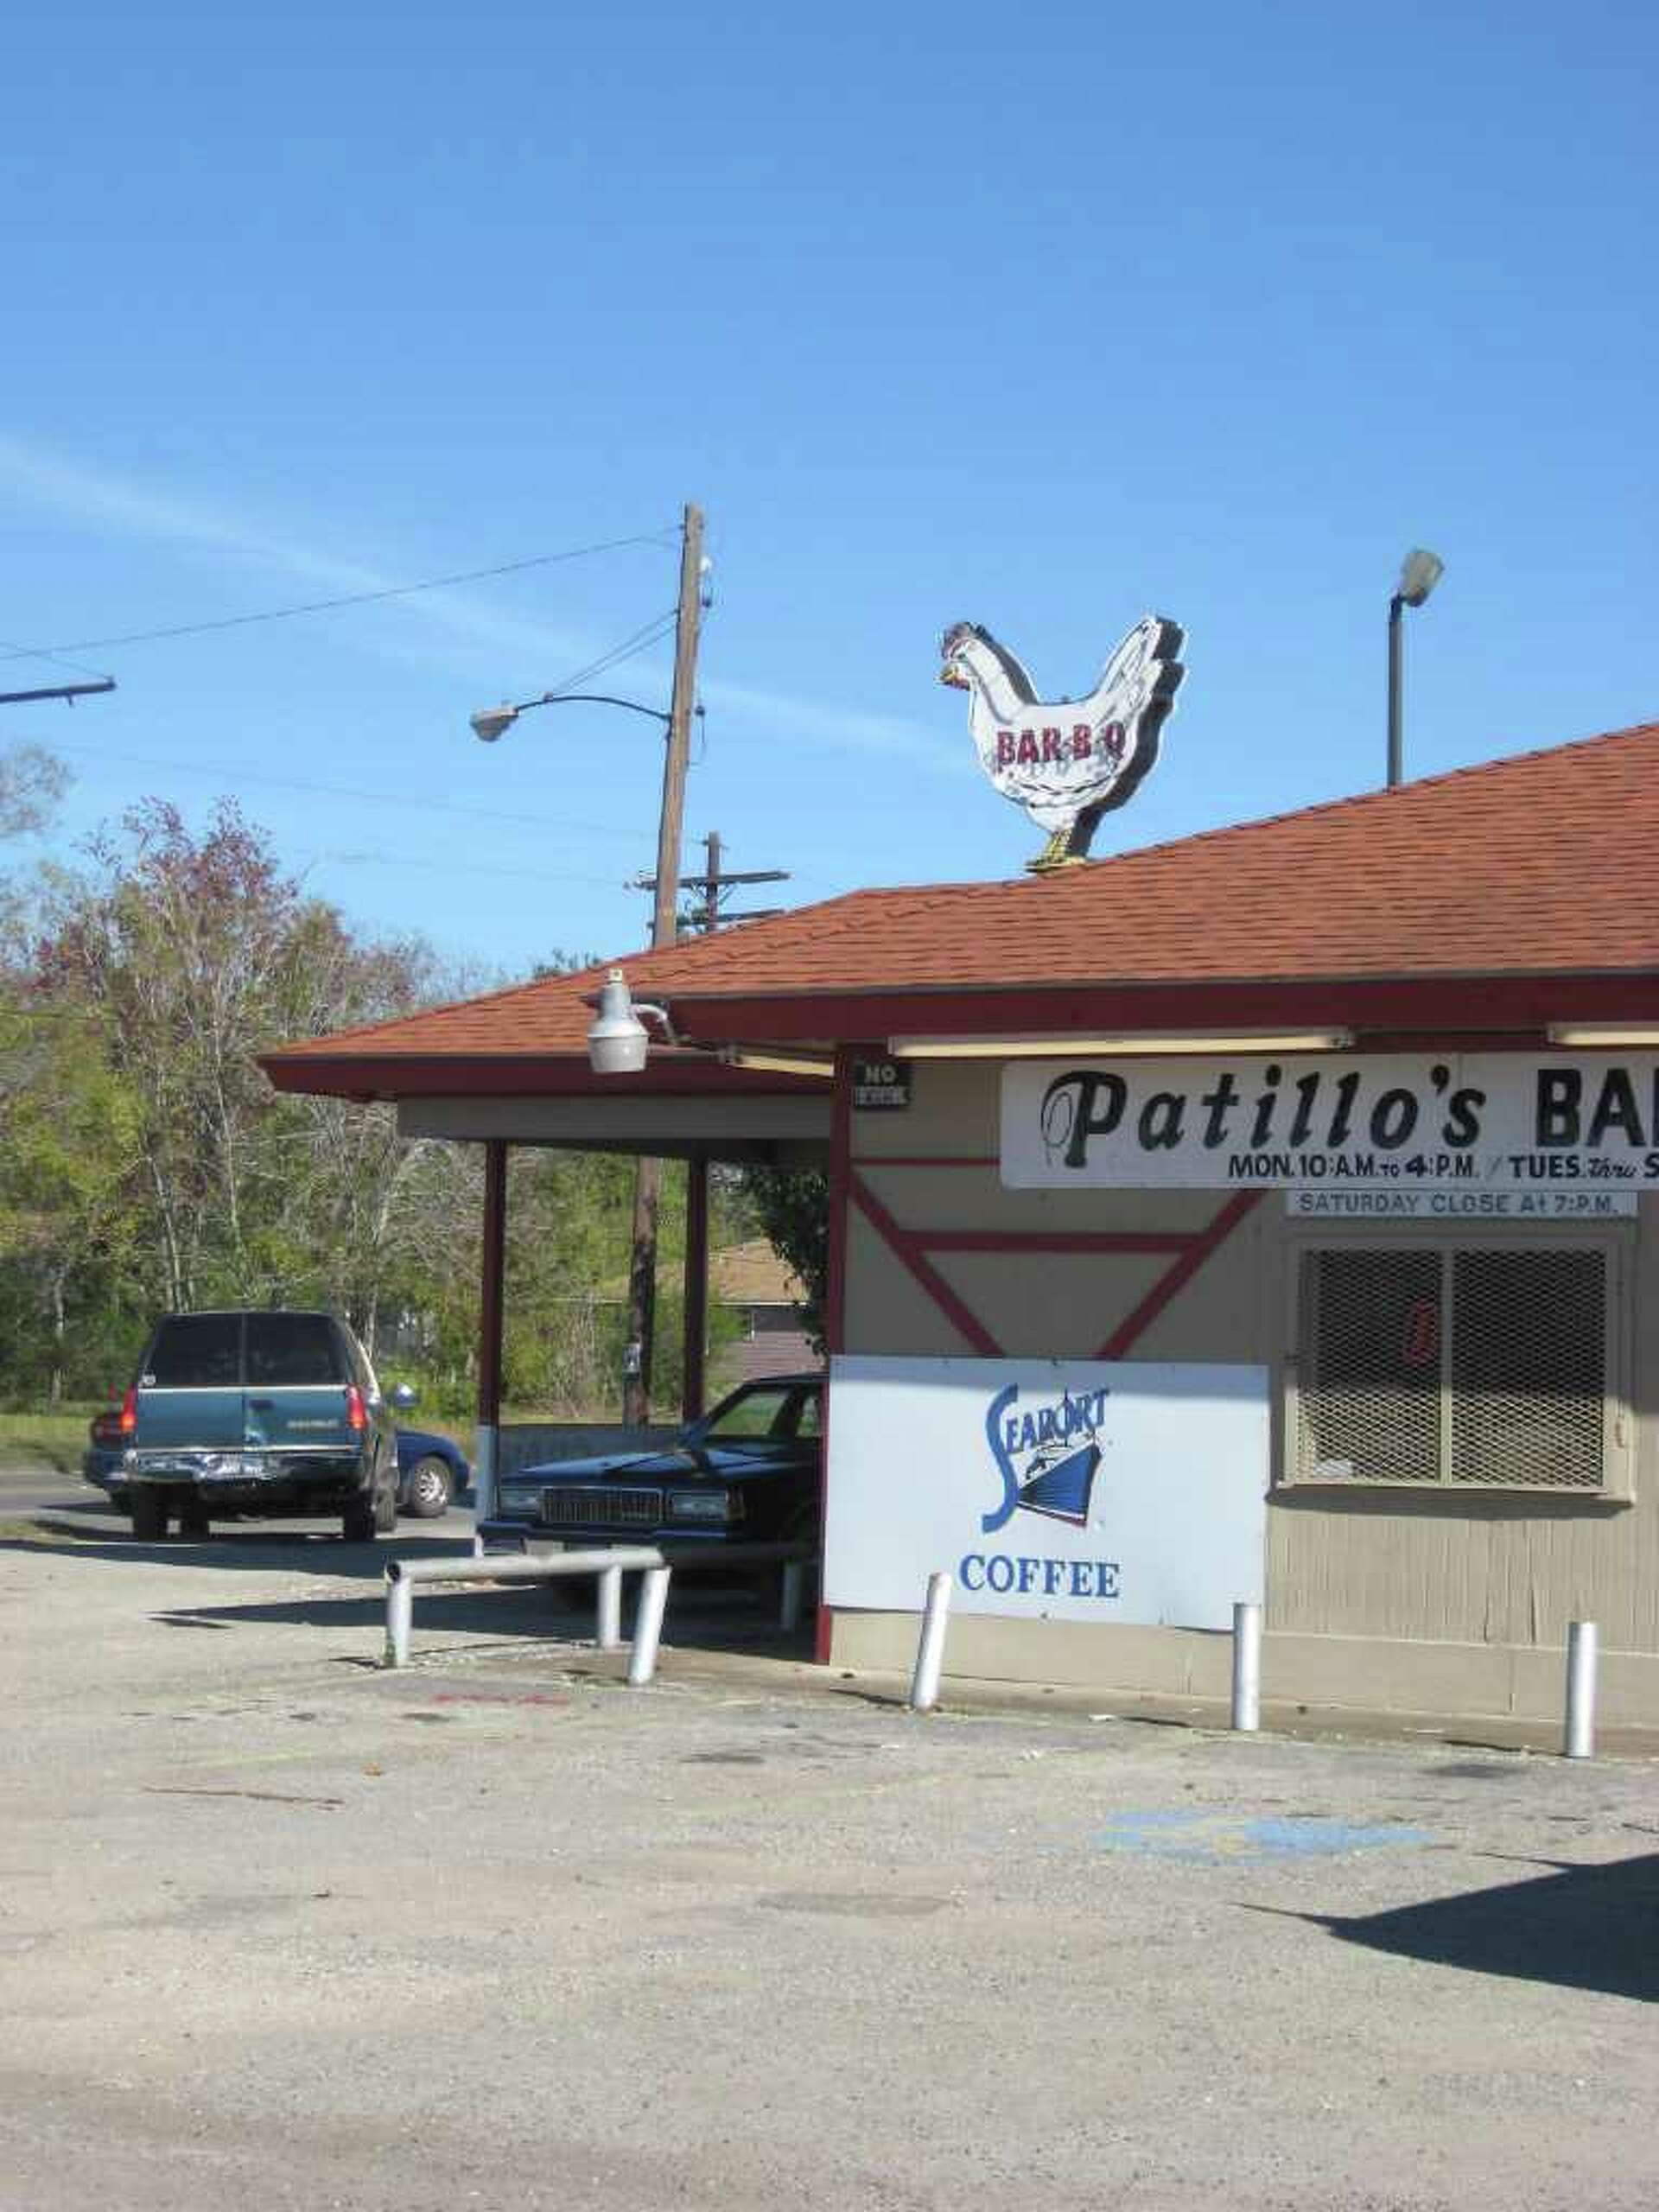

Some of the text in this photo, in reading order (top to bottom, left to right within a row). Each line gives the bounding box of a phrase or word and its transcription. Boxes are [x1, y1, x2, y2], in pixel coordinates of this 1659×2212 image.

[1040, 1064, 1487, 1168] Patillo's
[1300, 1193, 1418, 1211] SATURDAY
[1431, 1194, 1510, 1212] CLOSE
[982, 1382, 1109, 1534] SEAPORT
[959, 1554, 1120, 1598] COFFEE
